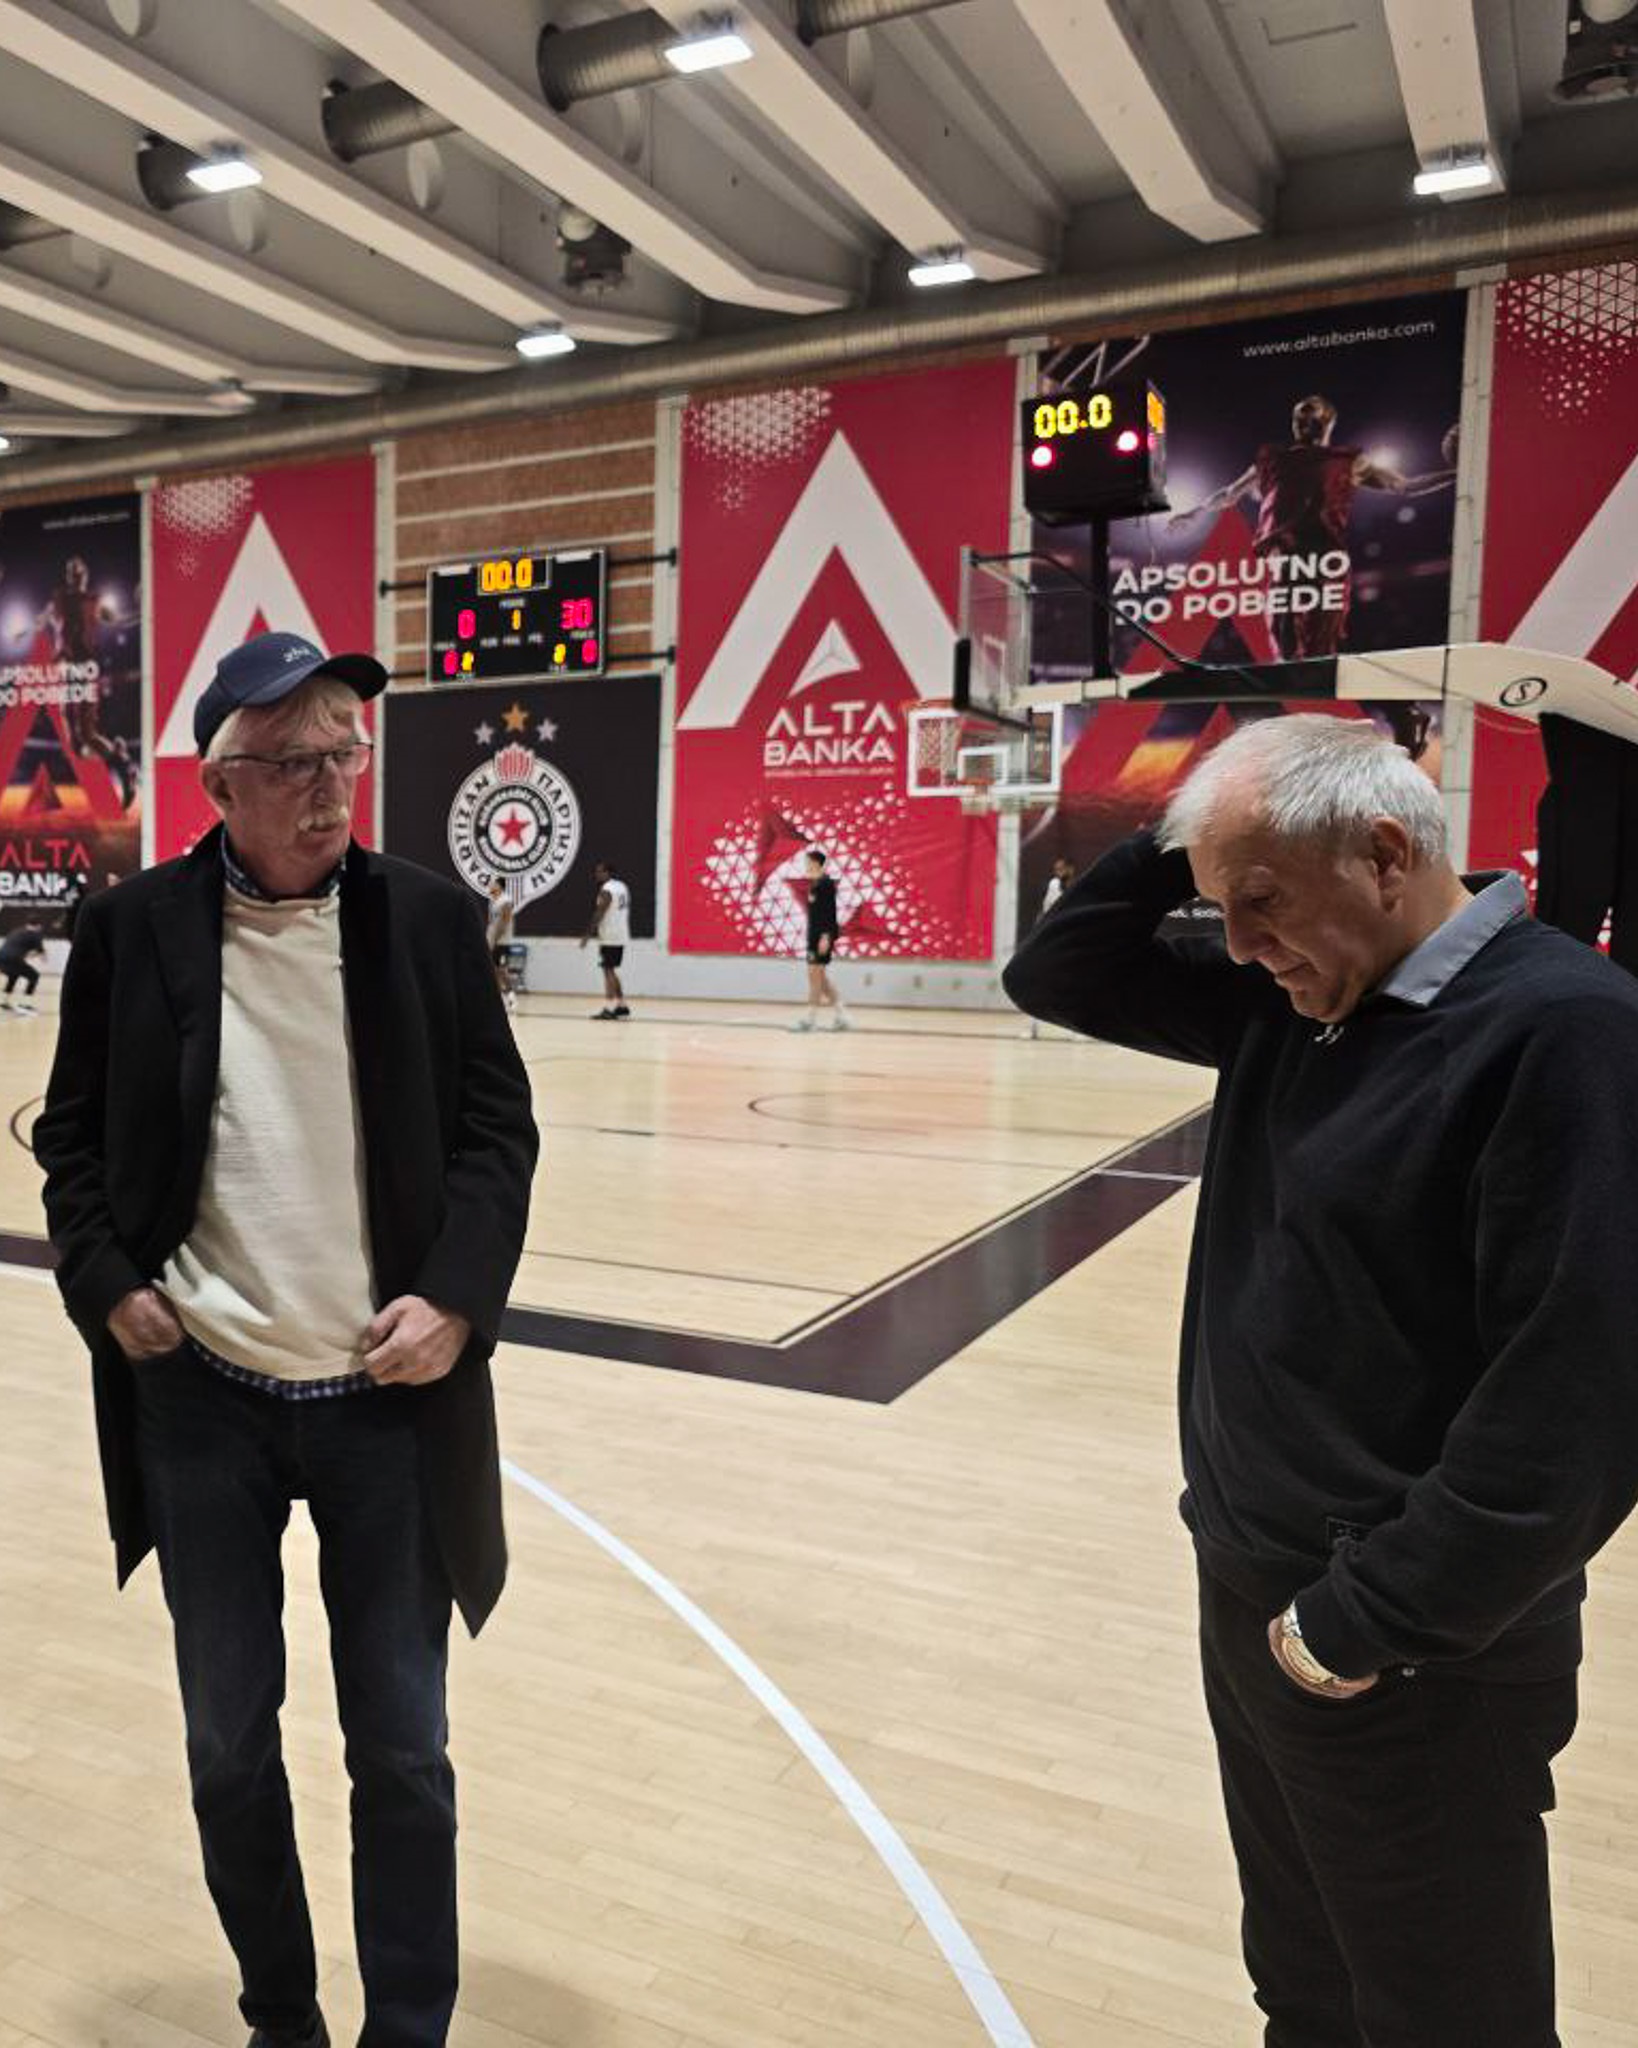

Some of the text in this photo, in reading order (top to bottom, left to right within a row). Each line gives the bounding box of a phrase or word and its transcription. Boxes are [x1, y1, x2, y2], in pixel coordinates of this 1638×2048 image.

[1243, 321, 1435, 357] www.altabanka.com
[1034, 394, 1112, 438] 00.0
[482, 558, 533, 592] 00.0
[1112, 551, 1350, 595] APSOLUTNO
[560, 598, 593, 630] 30
[1115, 583, 1345, 625] DO POBEDE
[0, 660, 99, 687] PSOLUTNO
[21, 681, 99, 705] POBEDE
[766, 702, 896, 737] ALTA
[763, 738, 895, 767] BANKA
[0, 839, 91, 870] ALTA
